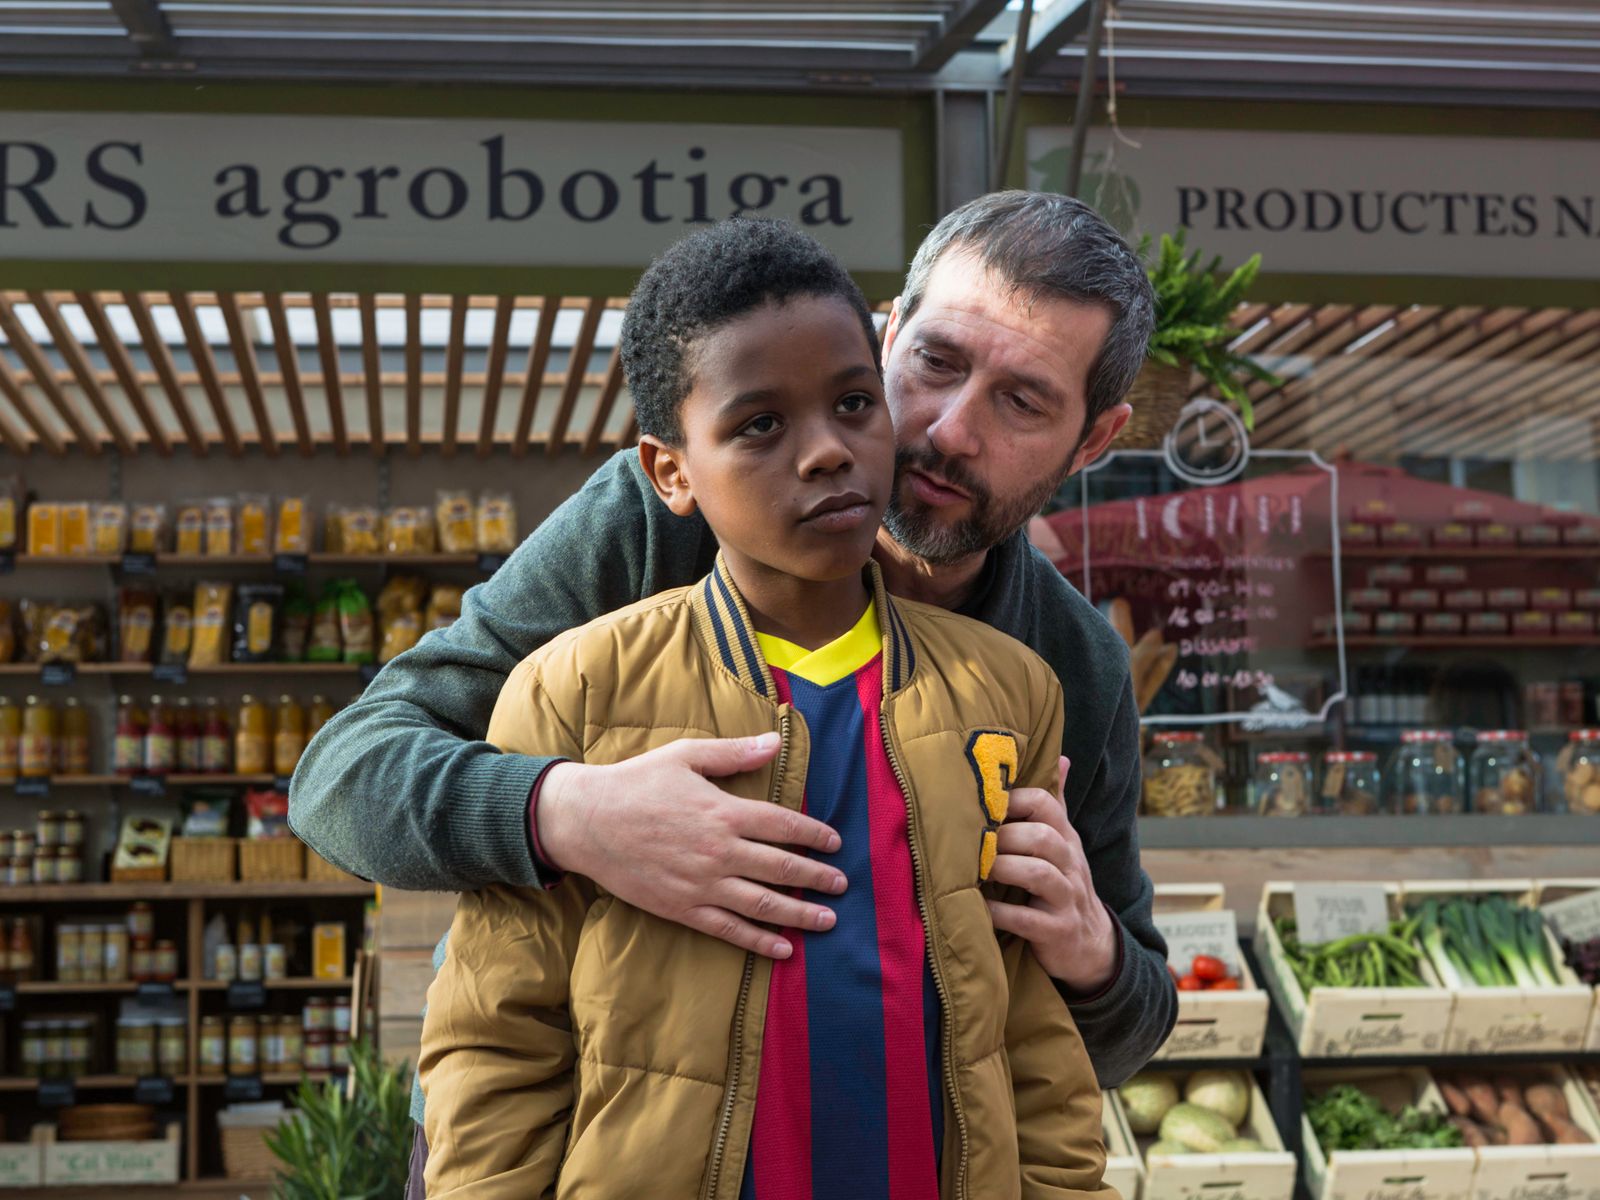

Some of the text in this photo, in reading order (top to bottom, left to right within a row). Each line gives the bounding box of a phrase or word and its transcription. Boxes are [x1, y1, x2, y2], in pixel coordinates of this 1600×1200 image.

[212, 134, 854, 250] agrobotiga
[1176, 186, 1600, 238] PRODUCTES N
